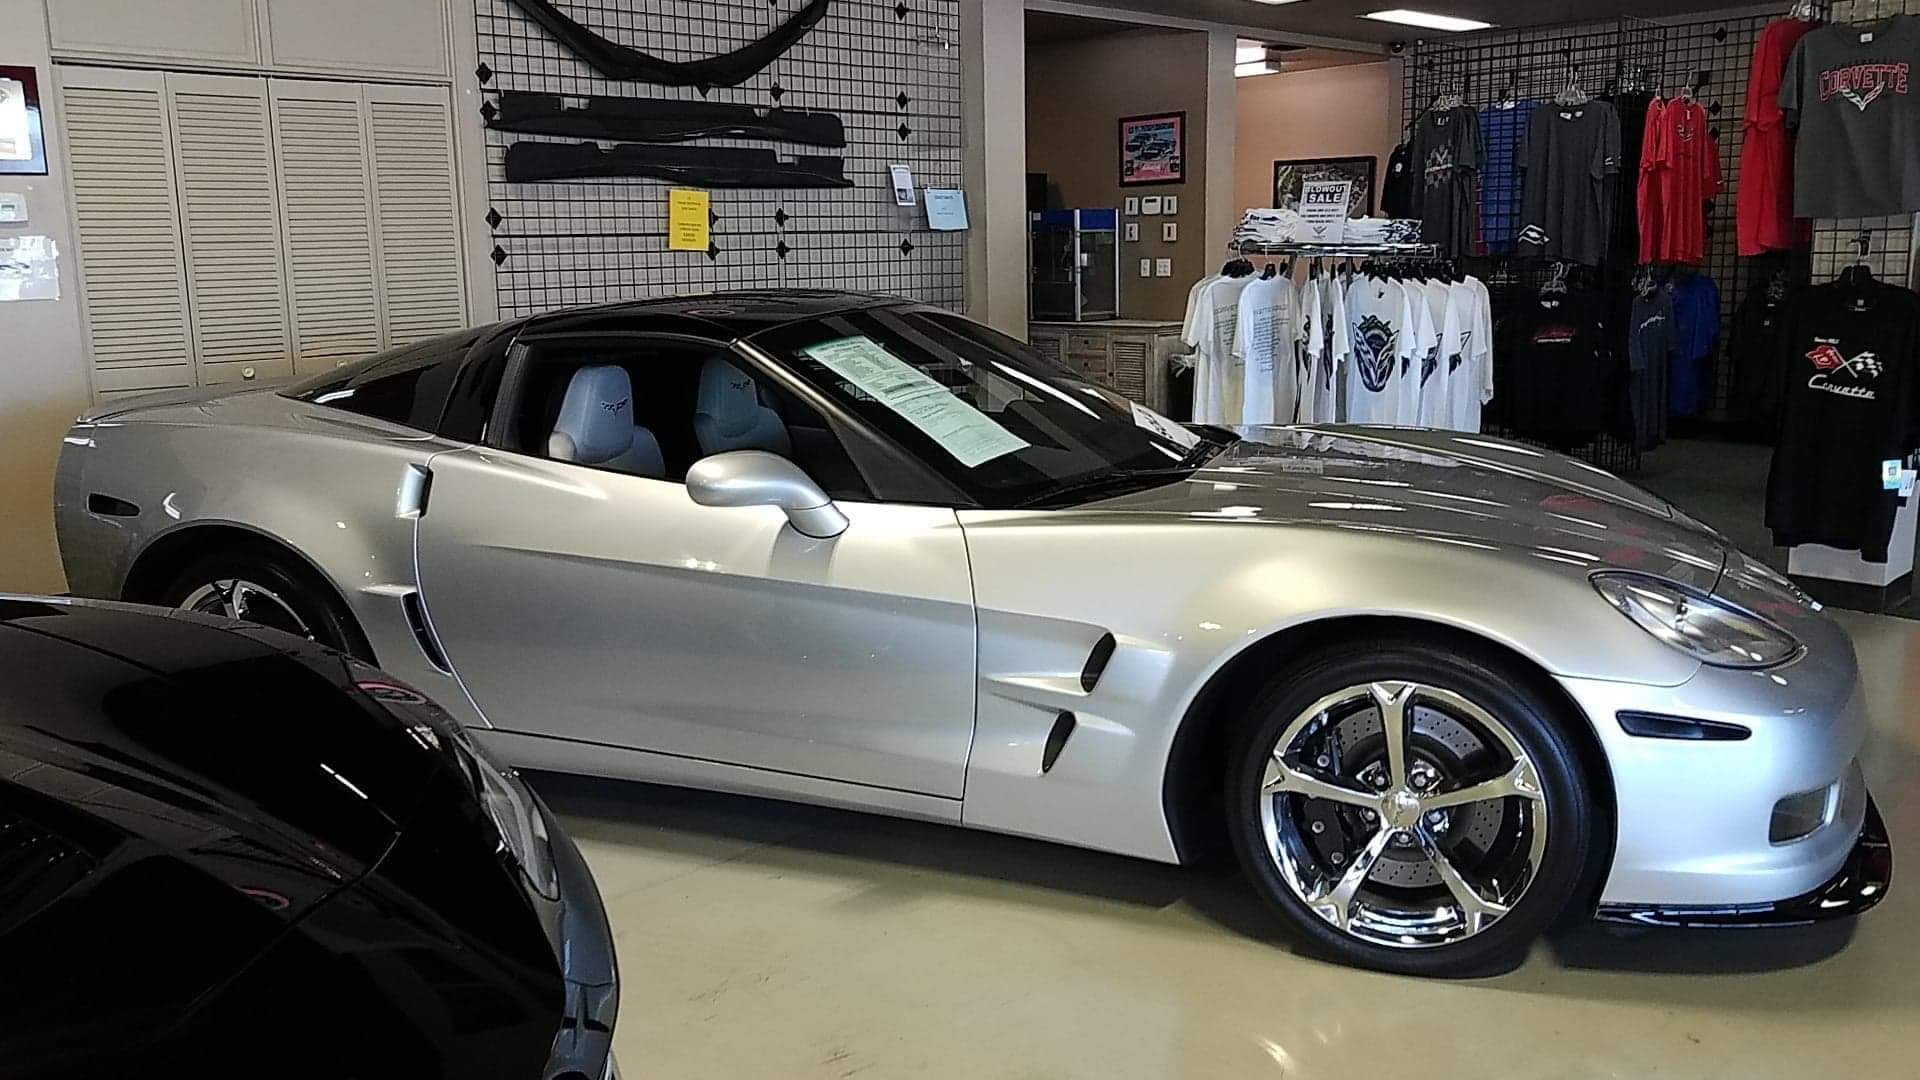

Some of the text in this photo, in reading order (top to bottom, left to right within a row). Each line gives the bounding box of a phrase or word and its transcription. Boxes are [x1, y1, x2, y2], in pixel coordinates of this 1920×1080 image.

[1819, 62, 1909, 101] CORVETTE
[1304, 185, 1347, 193] BLOWOUT
[1308, 193, 1342, 203] SALE
[1808, 374, 1876, 400] Corvette
